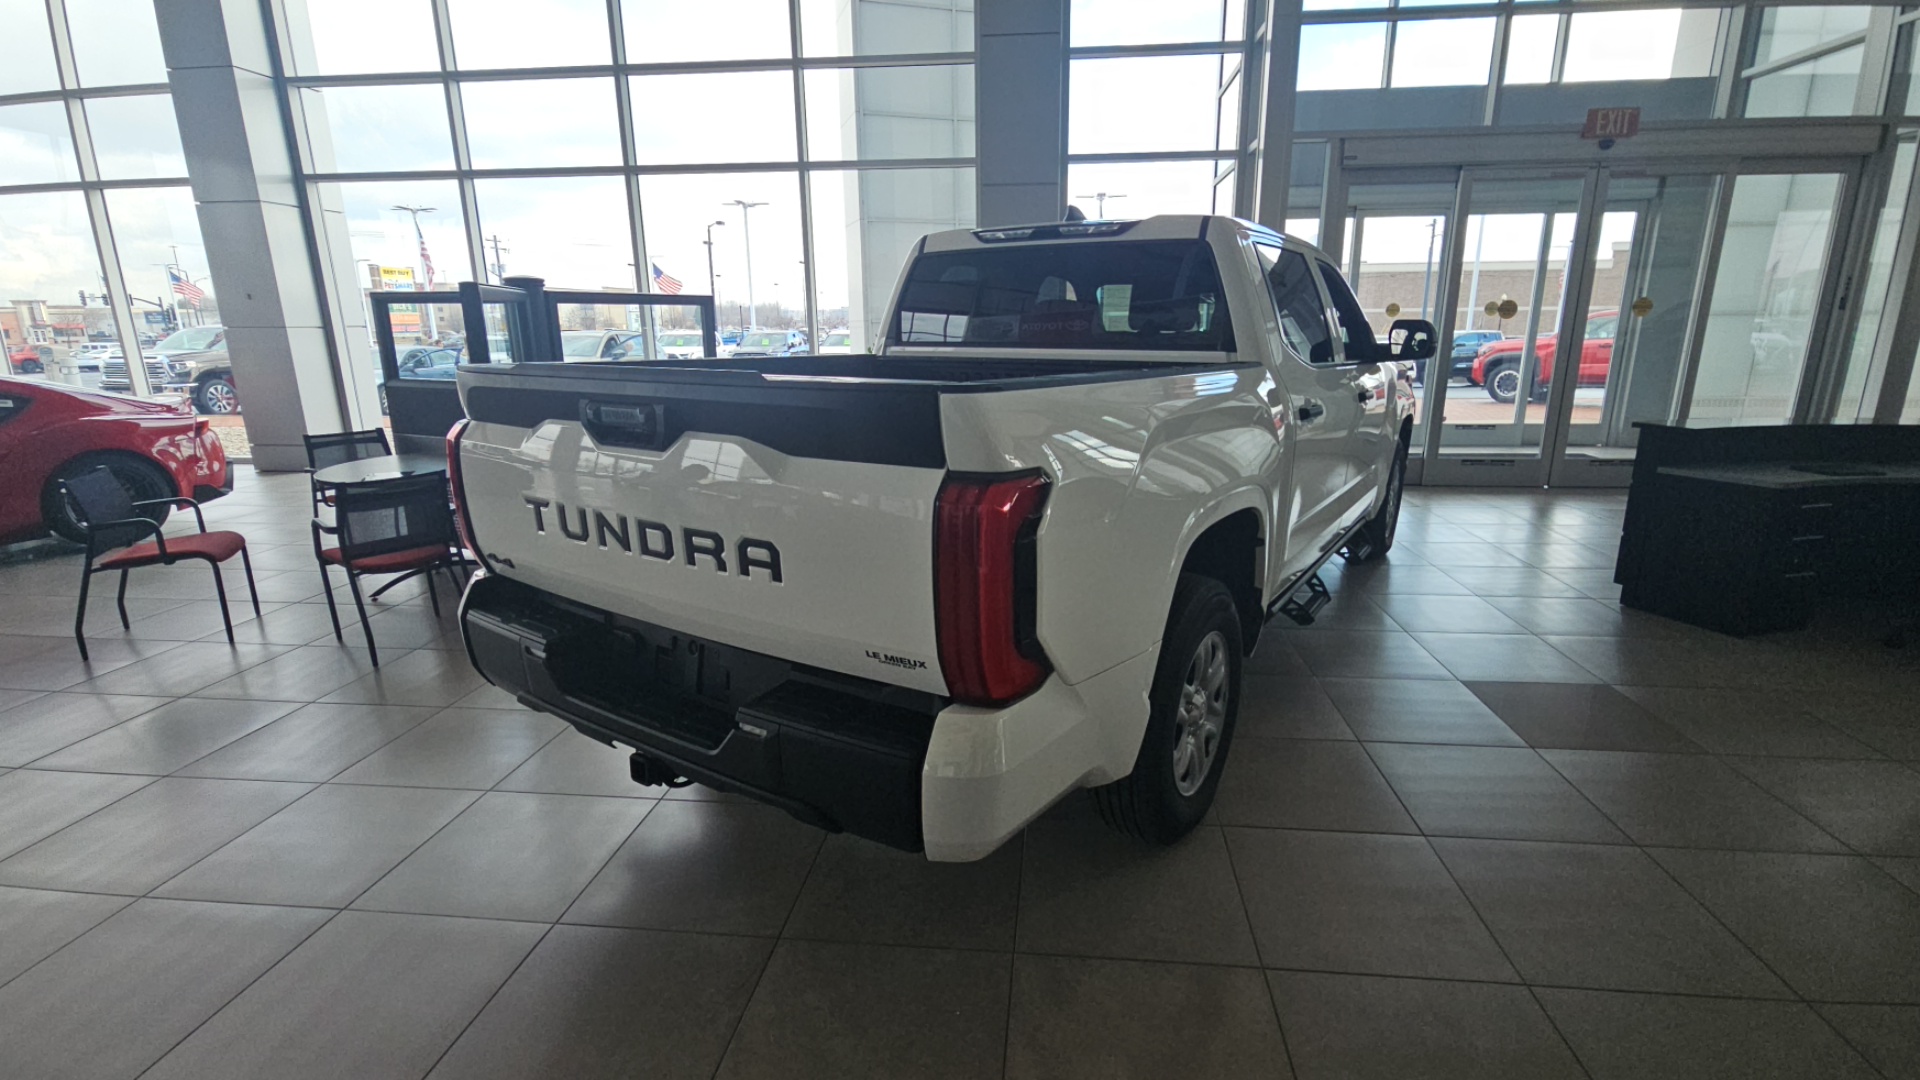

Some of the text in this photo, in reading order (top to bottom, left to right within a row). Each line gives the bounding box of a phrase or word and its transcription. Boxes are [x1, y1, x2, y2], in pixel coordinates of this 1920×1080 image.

[1596, 109, 1632, 134] EXIT
[523, 496, 783, 586] TUNDRA
[865, 650, 927, 669] LE MIEUX
